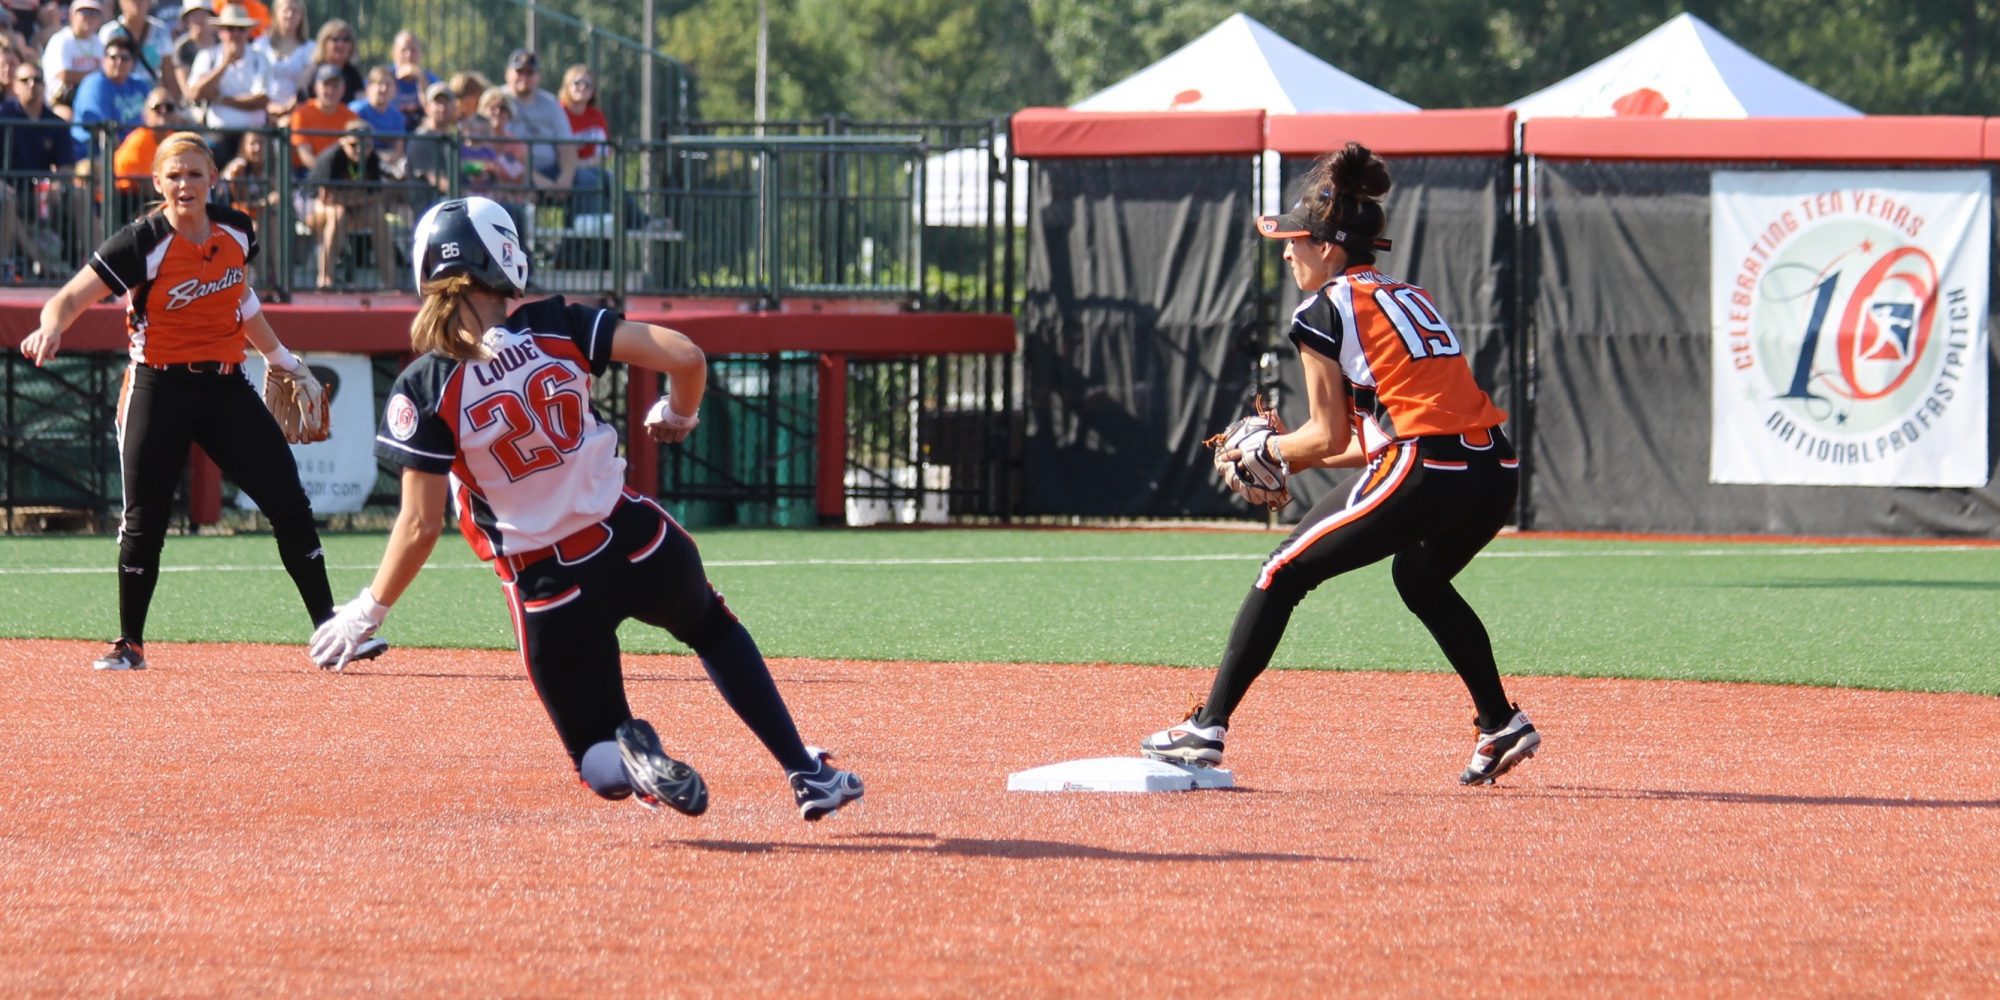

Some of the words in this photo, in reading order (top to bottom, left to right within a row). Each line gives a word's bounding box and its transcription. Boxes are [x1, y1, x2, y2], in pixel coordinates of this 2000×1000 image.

[164, 267, 244, 312] Bandits
[440, 242, 460, 259] 26
[1730, 210, 1798, 370] CELEBRATING
[1801, 190, 1843, 221] TEN
[1851, 189, 1925, 237] YEARS
[473, 338, 540, 388] LOWE
[1372, 287, 1461, 361] 19
[1761, 246, 1940, 401] 10
[463, 361, 584, 484] 26
[1766, 410, 1873, 464] NATIONAL
[1876, 420, 1920, 458] PRO
[1915, 287, 1969, 431] FASTPITCH
